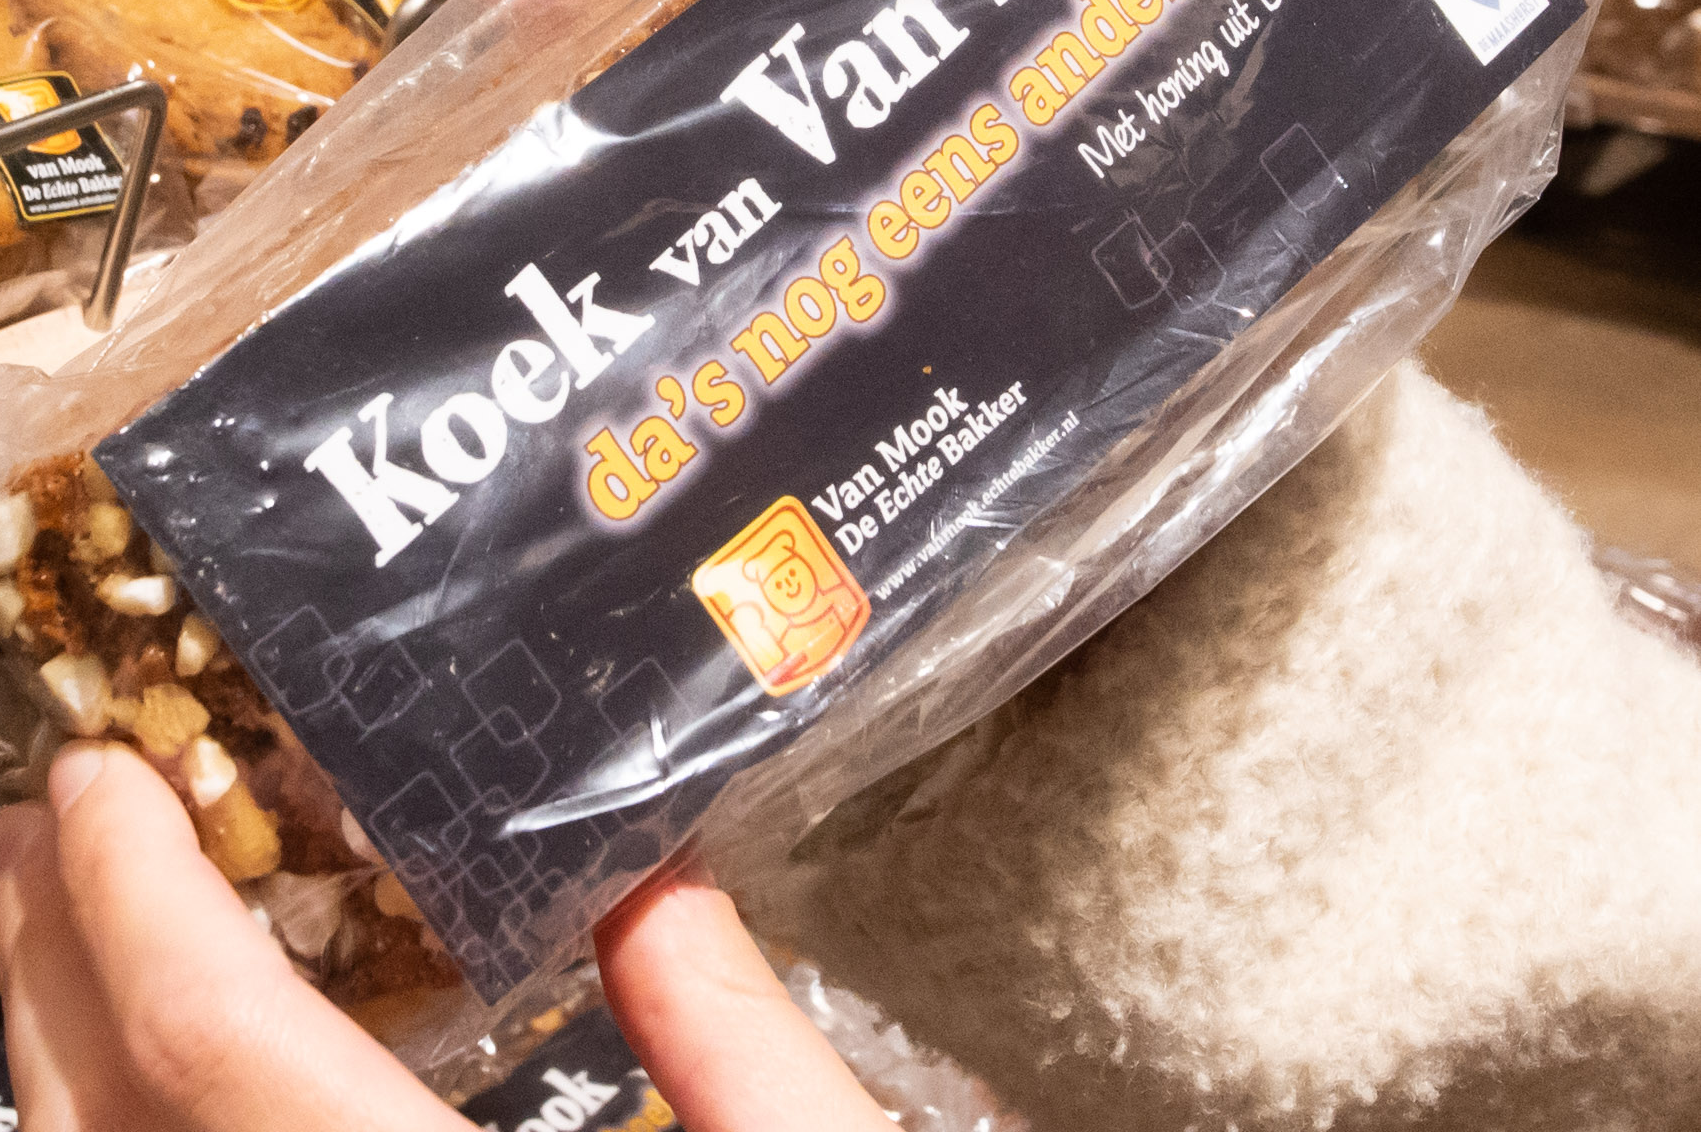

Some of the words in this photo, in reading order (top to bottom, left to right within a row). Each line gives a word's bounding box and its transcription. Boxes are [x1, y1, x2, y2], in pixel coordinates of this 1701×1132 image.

[56, 152, 107, 176] Mook
[1077, 109, 1146, 179] Met
[1134, 40, 1230, 125] honing
[730, 235, 886, 386] nog
[867, 102, 1021, 260] eens
[302, 262, 657, 569] Koek
[648, 177, 783, 286] van
[810, 463, 886, 522] Van
[874, 386, 970, 473] Mook
[834, 514, 879, 557] De
[873, 455, 945, 525] Echte
[936, 380, 1028, 466] Bakker
